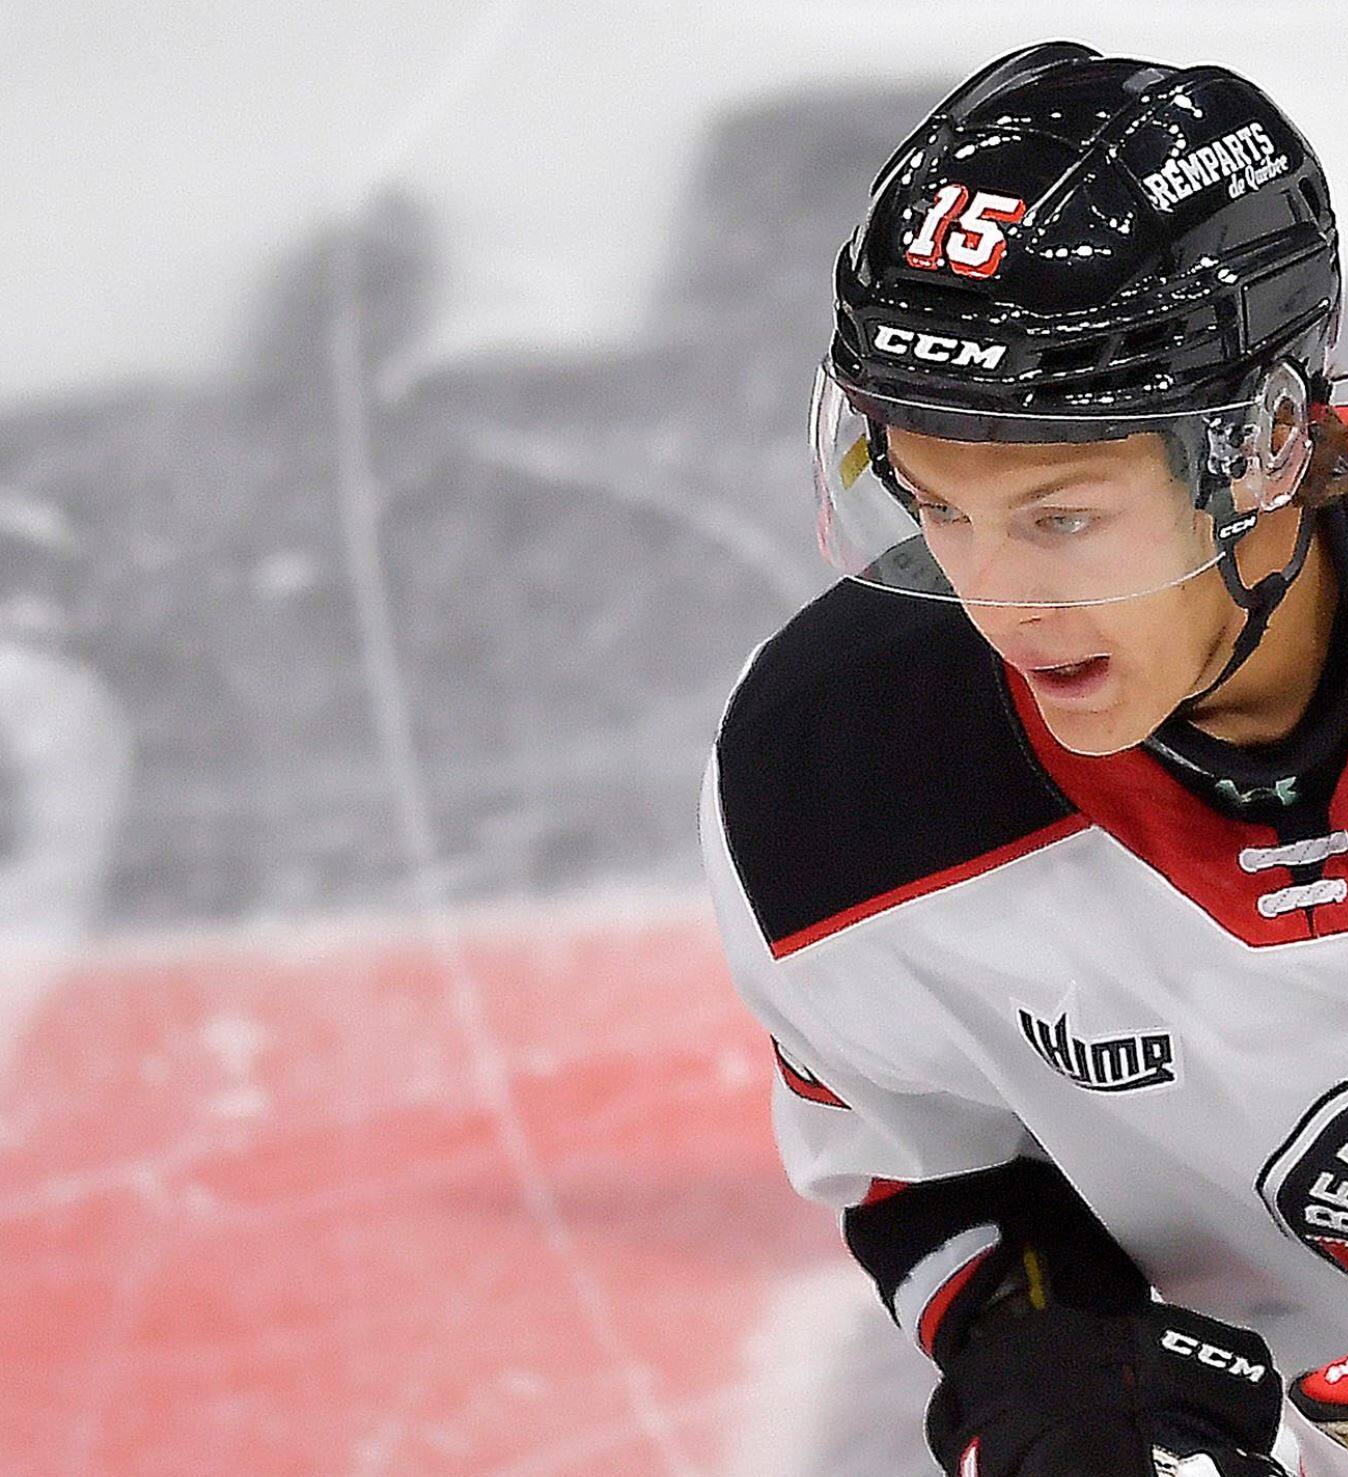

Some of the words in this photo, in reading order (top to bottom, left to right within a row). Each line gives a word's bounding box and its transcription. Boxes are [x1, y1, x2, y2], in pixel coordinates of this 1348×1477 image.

[1143, 123, 1275, 212] REMPARTS
[1228, 173, 1246, 199] de
[906, 184, 1026, 279] 15
[874, 325, 1007, 369] CCM
[1161, 1329, 1267, 1383] CCM
